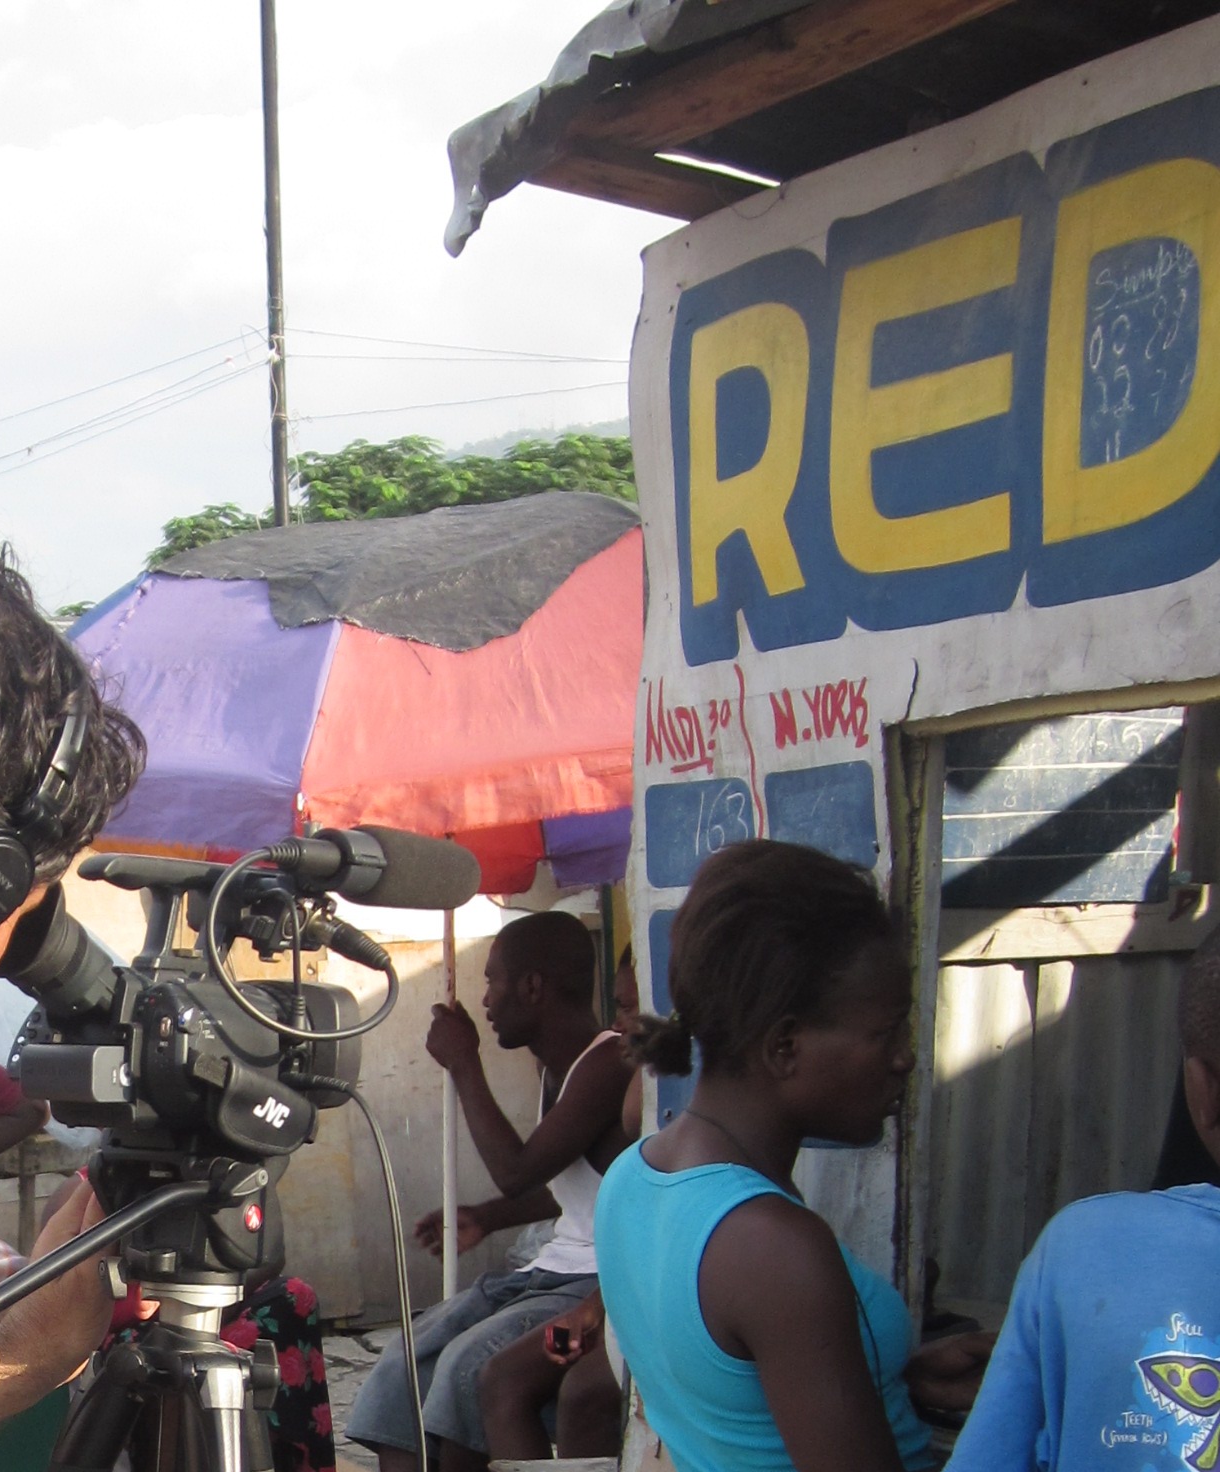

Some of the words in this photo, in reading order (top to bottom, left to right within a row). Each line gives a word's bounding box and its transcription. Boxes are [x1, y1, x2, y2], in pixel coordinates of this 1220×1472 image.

[689, 156, 1220, 607] RED
[252, 1096, 291, 1129] JVC
[1166, 1312, 1204, 1342] SKULL
[1121, 1411, 1154, 1428] TEETH
